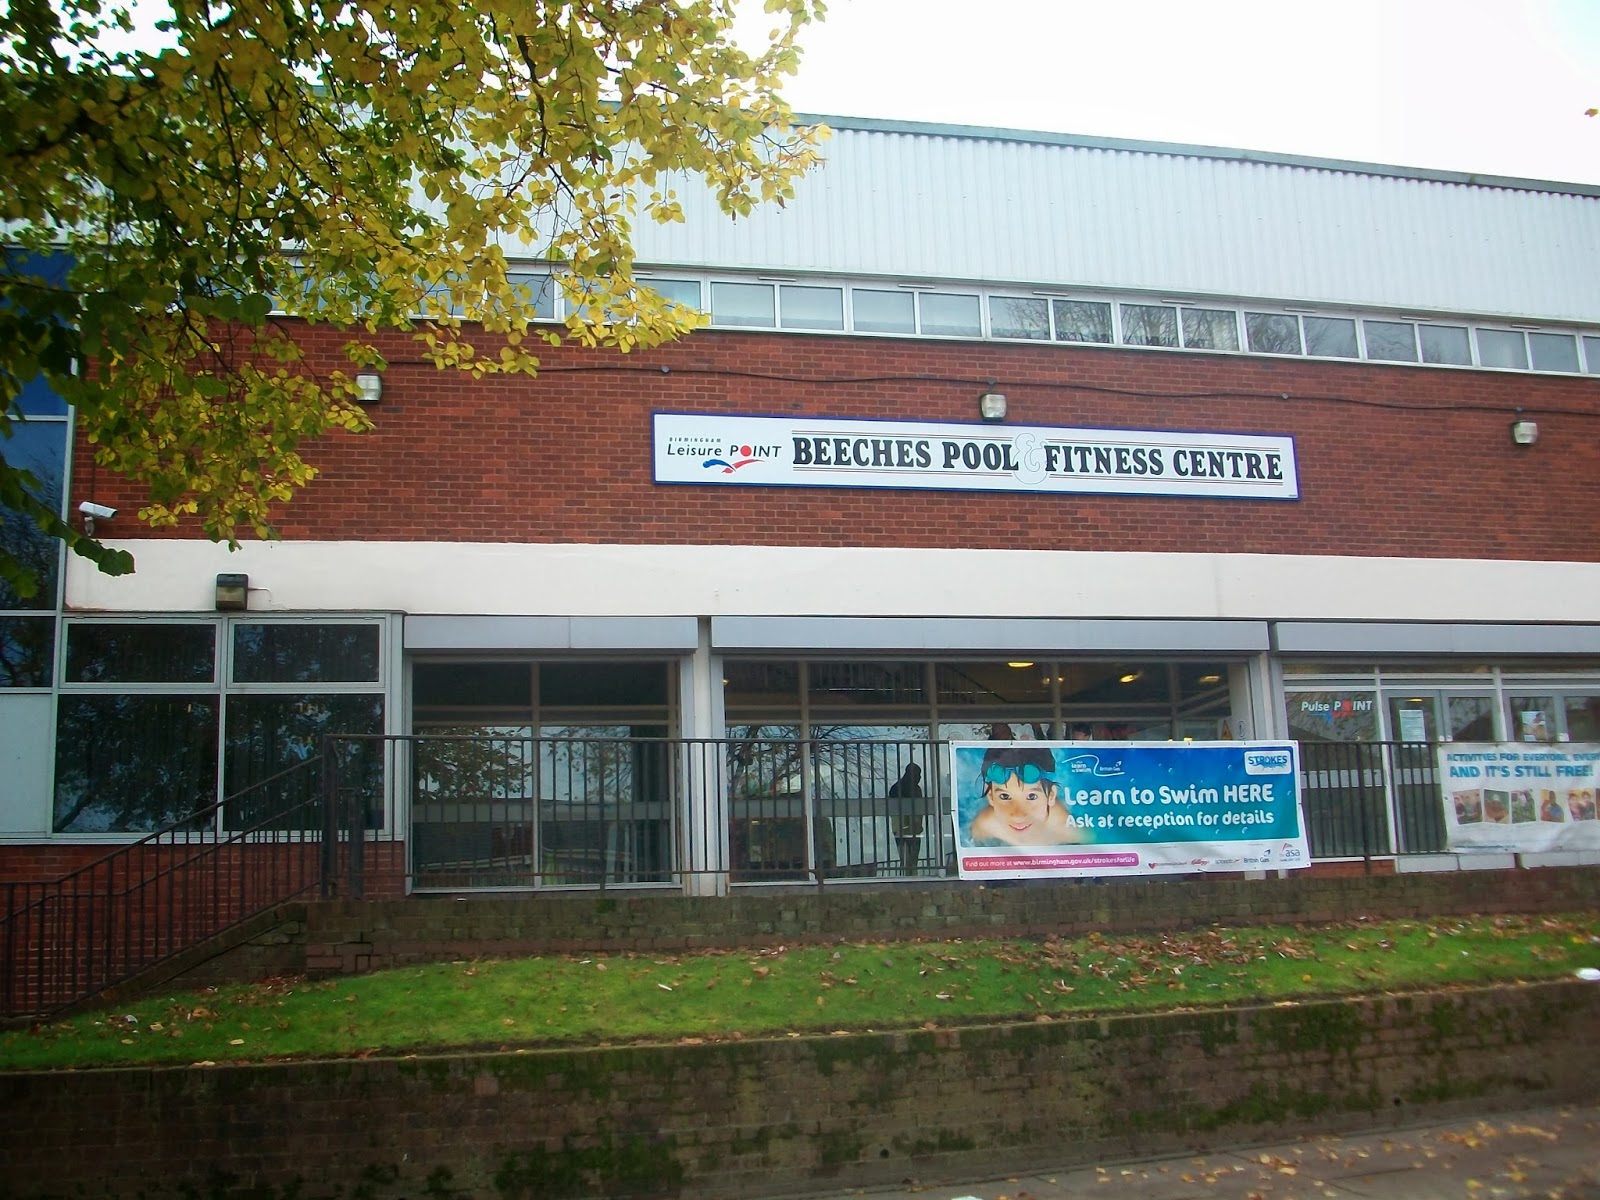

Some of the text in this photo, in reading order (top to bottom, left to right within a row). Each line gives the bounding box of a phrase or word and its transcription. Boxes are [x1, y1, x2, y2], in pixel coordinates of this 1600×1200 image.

[667, 443, 783, 458] Leisure POINT
[792, 437, 932, 468] BEECHES
[942, 441, 1019, 471] POOL
[1044, 445, 1164, 476] FITNESS
[1173, 450, 1284, 480] CENTRE
[1301, 700, 1373, 712] Pulse POINT
[1248, 755, 1288, 766] STROKES
[1447, 753, 1497, 761] ACTIVITIES
[1500, 753, 1519, 761] FOR
[1450, 765, 1594, 778] AND IT'S STILL FREE!
[1064, 783, 1275, 805] Learn to Swim HERE
[1066, 809, 1275, 829] Ask at reception for details
[1285, 849, 1301, 857] asa
